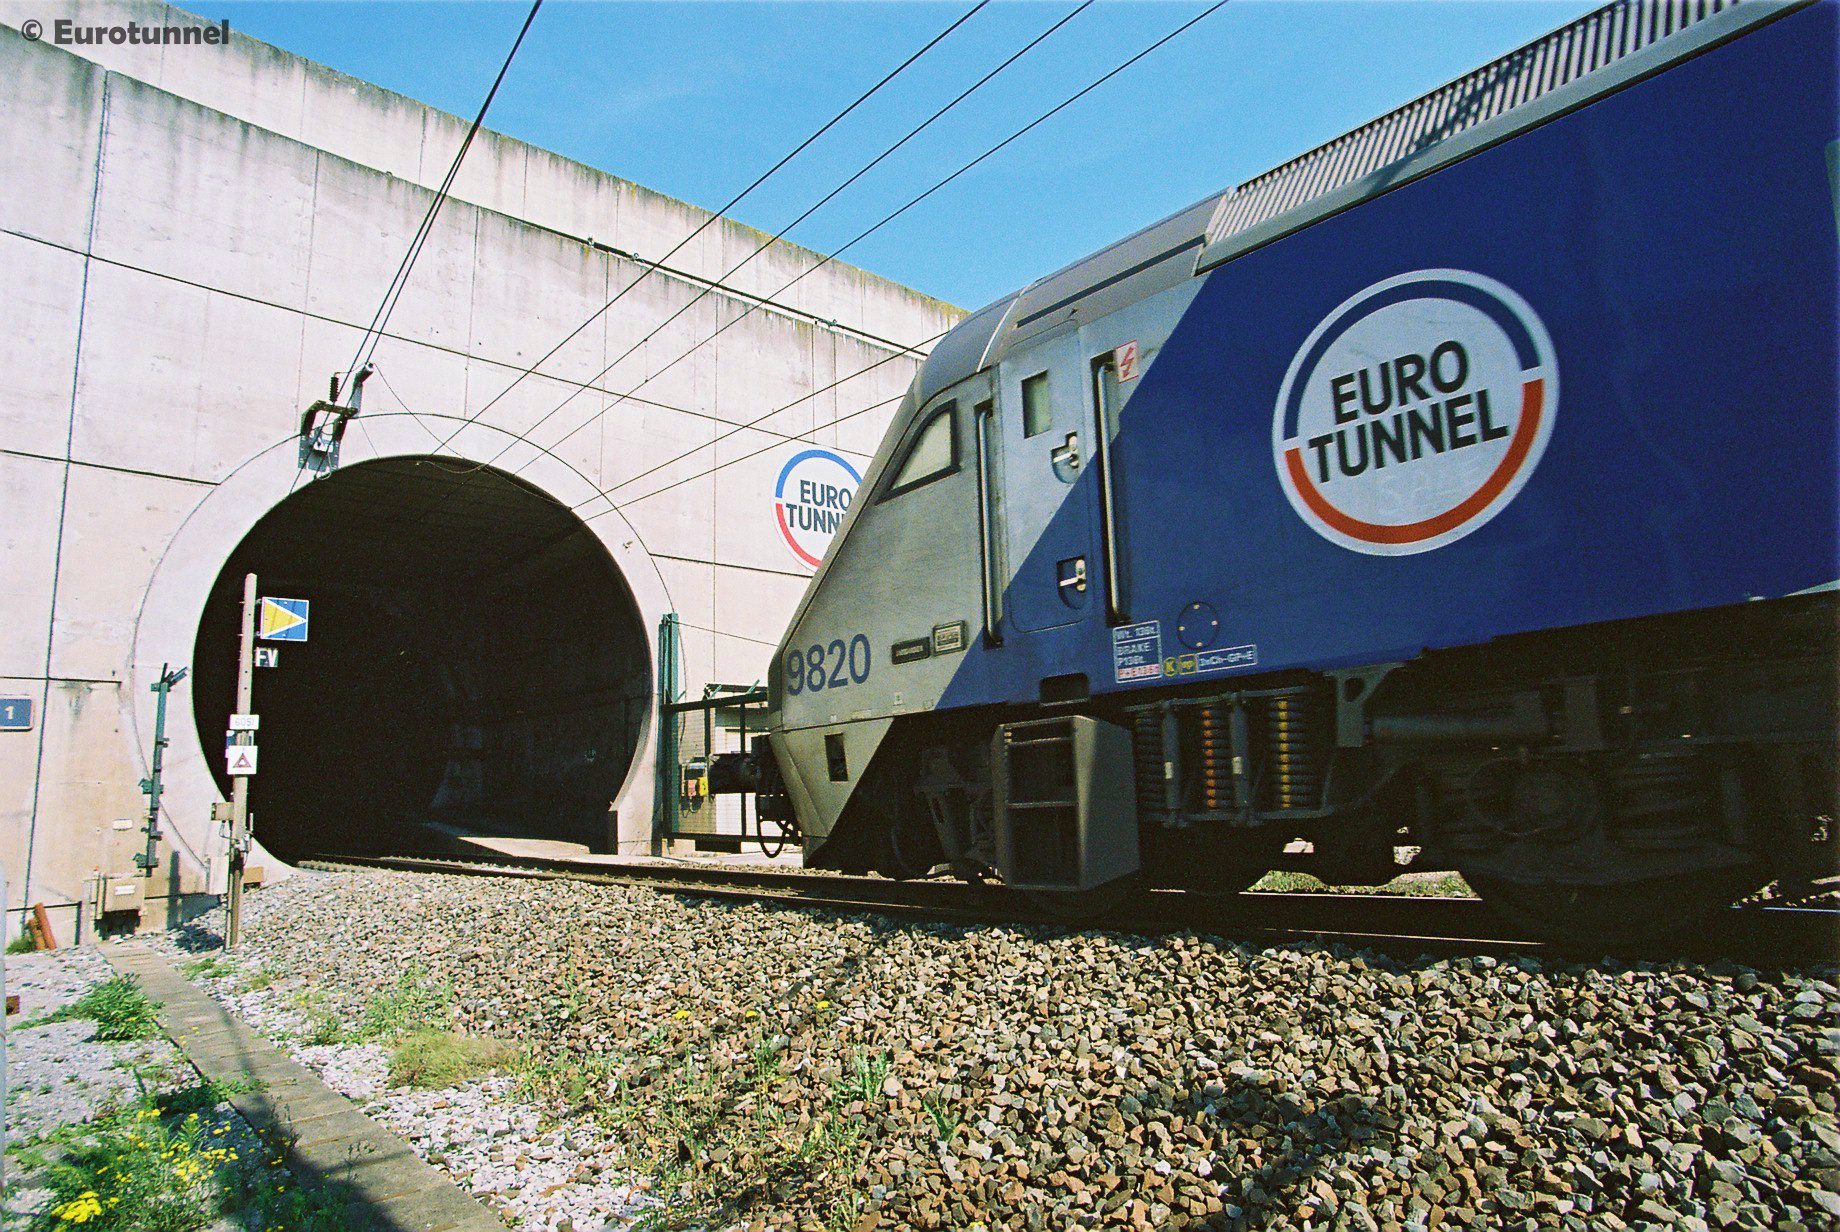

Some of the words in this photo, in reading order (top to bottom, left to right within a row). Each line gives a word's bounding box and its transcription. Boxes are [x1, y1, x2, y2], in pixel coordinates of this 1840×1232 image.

[1330, 340, 1469, 425] EURO
[1308, 388, 1509, 483] TUNNEL
[800, 479, 853, 513] EURO
[785, 502, 846, 535] TUNN
[787, 633, 871, 696] 9820
[1117, 642, 1151, 655] BRAKE
[4, 705, 14, 720] 1
